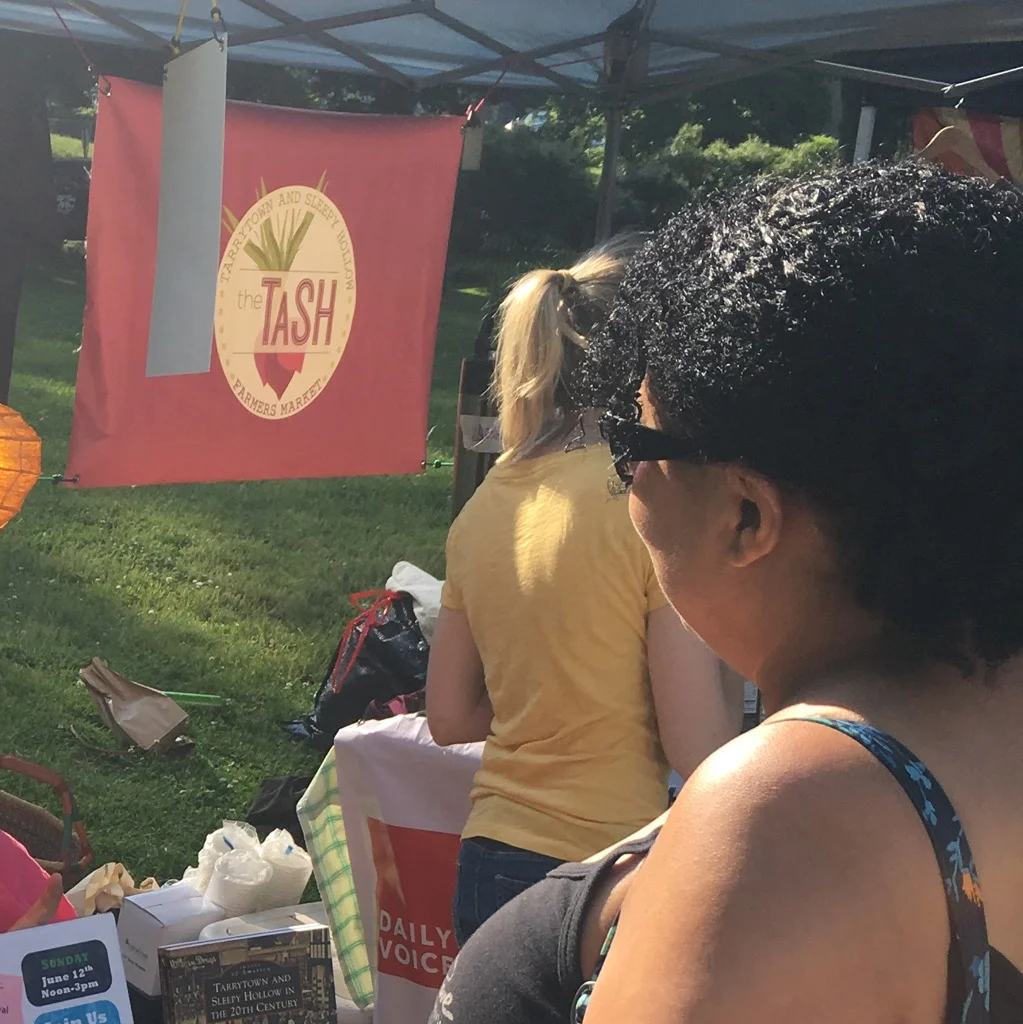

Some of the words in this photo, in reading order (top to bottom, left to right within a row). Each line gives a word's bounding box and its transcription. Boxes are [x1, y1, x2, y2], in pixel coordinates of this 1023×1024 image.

[220, 199, 273, 284] TARRYTOWN
[278, 190, 302, 206] AND
[304, 193, 340, 230] SLEEPY
[337, 231, 354, 291] HOLLOW
[237, 289, 263, 310] the
[261, 277, 338, 346] TASH
[232, 379, 277, 417] FARMERS
[279, 377, 324, 416] MARKET
[379, 909, 452, 949] DAILY
[41, 952, 89, 970] SUNDAY
[41, 973, 70, 988] June
[72, 965, 94, 980] 12th
[213, 978, 269, 993] TARRYTOWN
[272, 973, 291, 984] AND
[41, 980, 99, 999] Noon-3pm
[211, 994, 241, 1007] SLEEPY
[244, 988, 284, 1002] HOLLOW
[285, 986, 295, 995] IN
[211, 1011, 227, 1020] THE
[230, 1006, 254, 1017] 20TH
[256, 998, 299, 1013] CENTURY
